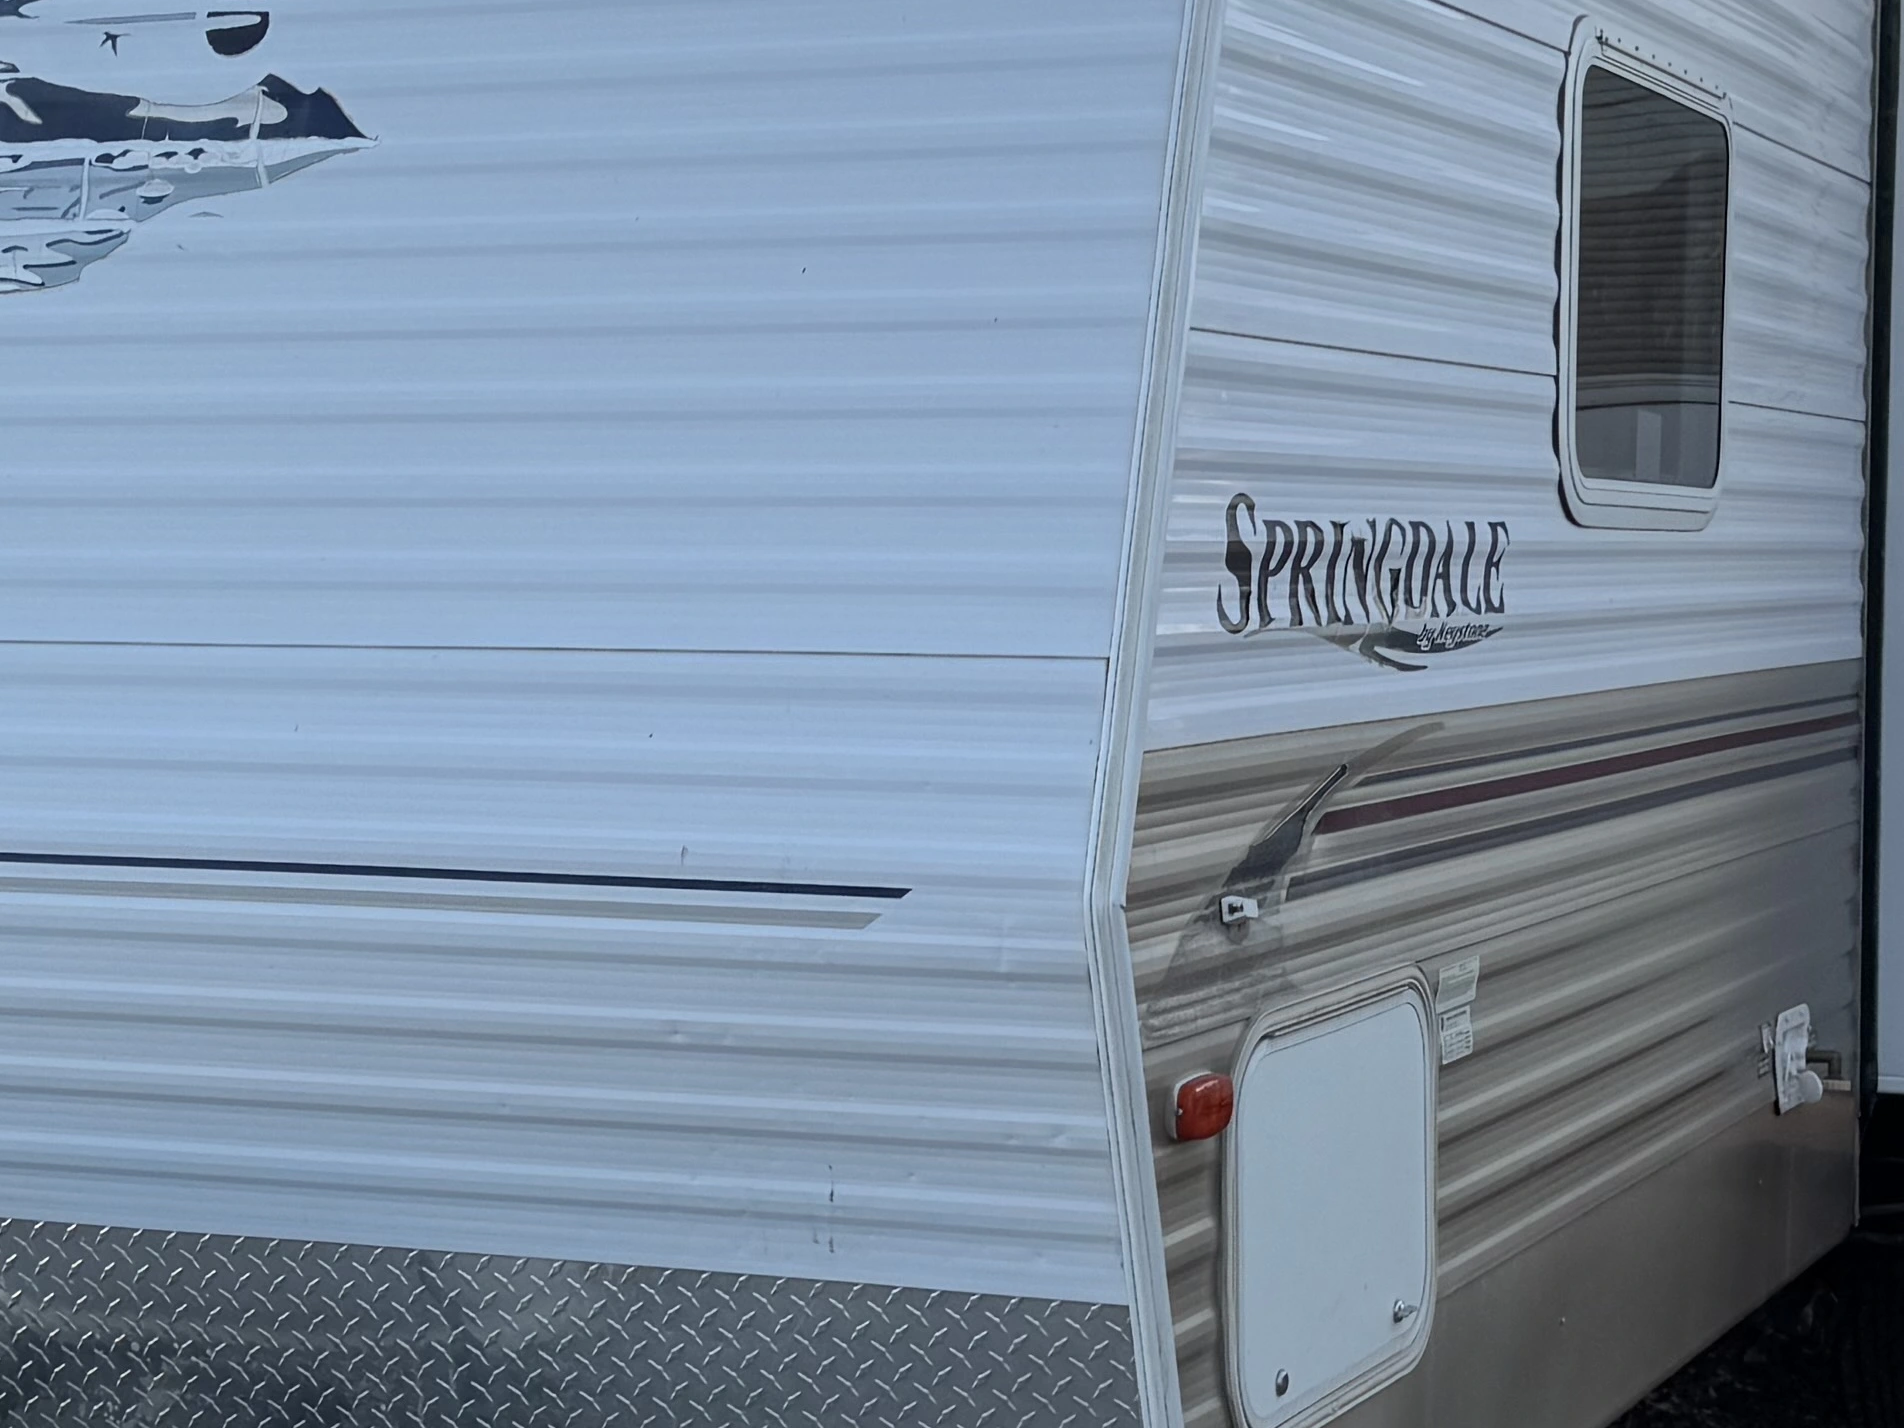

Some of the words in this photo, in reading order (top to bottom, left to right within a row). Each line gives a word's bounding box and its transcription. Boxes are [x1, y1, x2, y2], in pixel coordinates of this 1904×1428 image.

[1216, 492, 1512, 635] SPRINGDALE
[1416, 623, 1436, 651] by
[1433, 620, 1490, 649] Keystone
